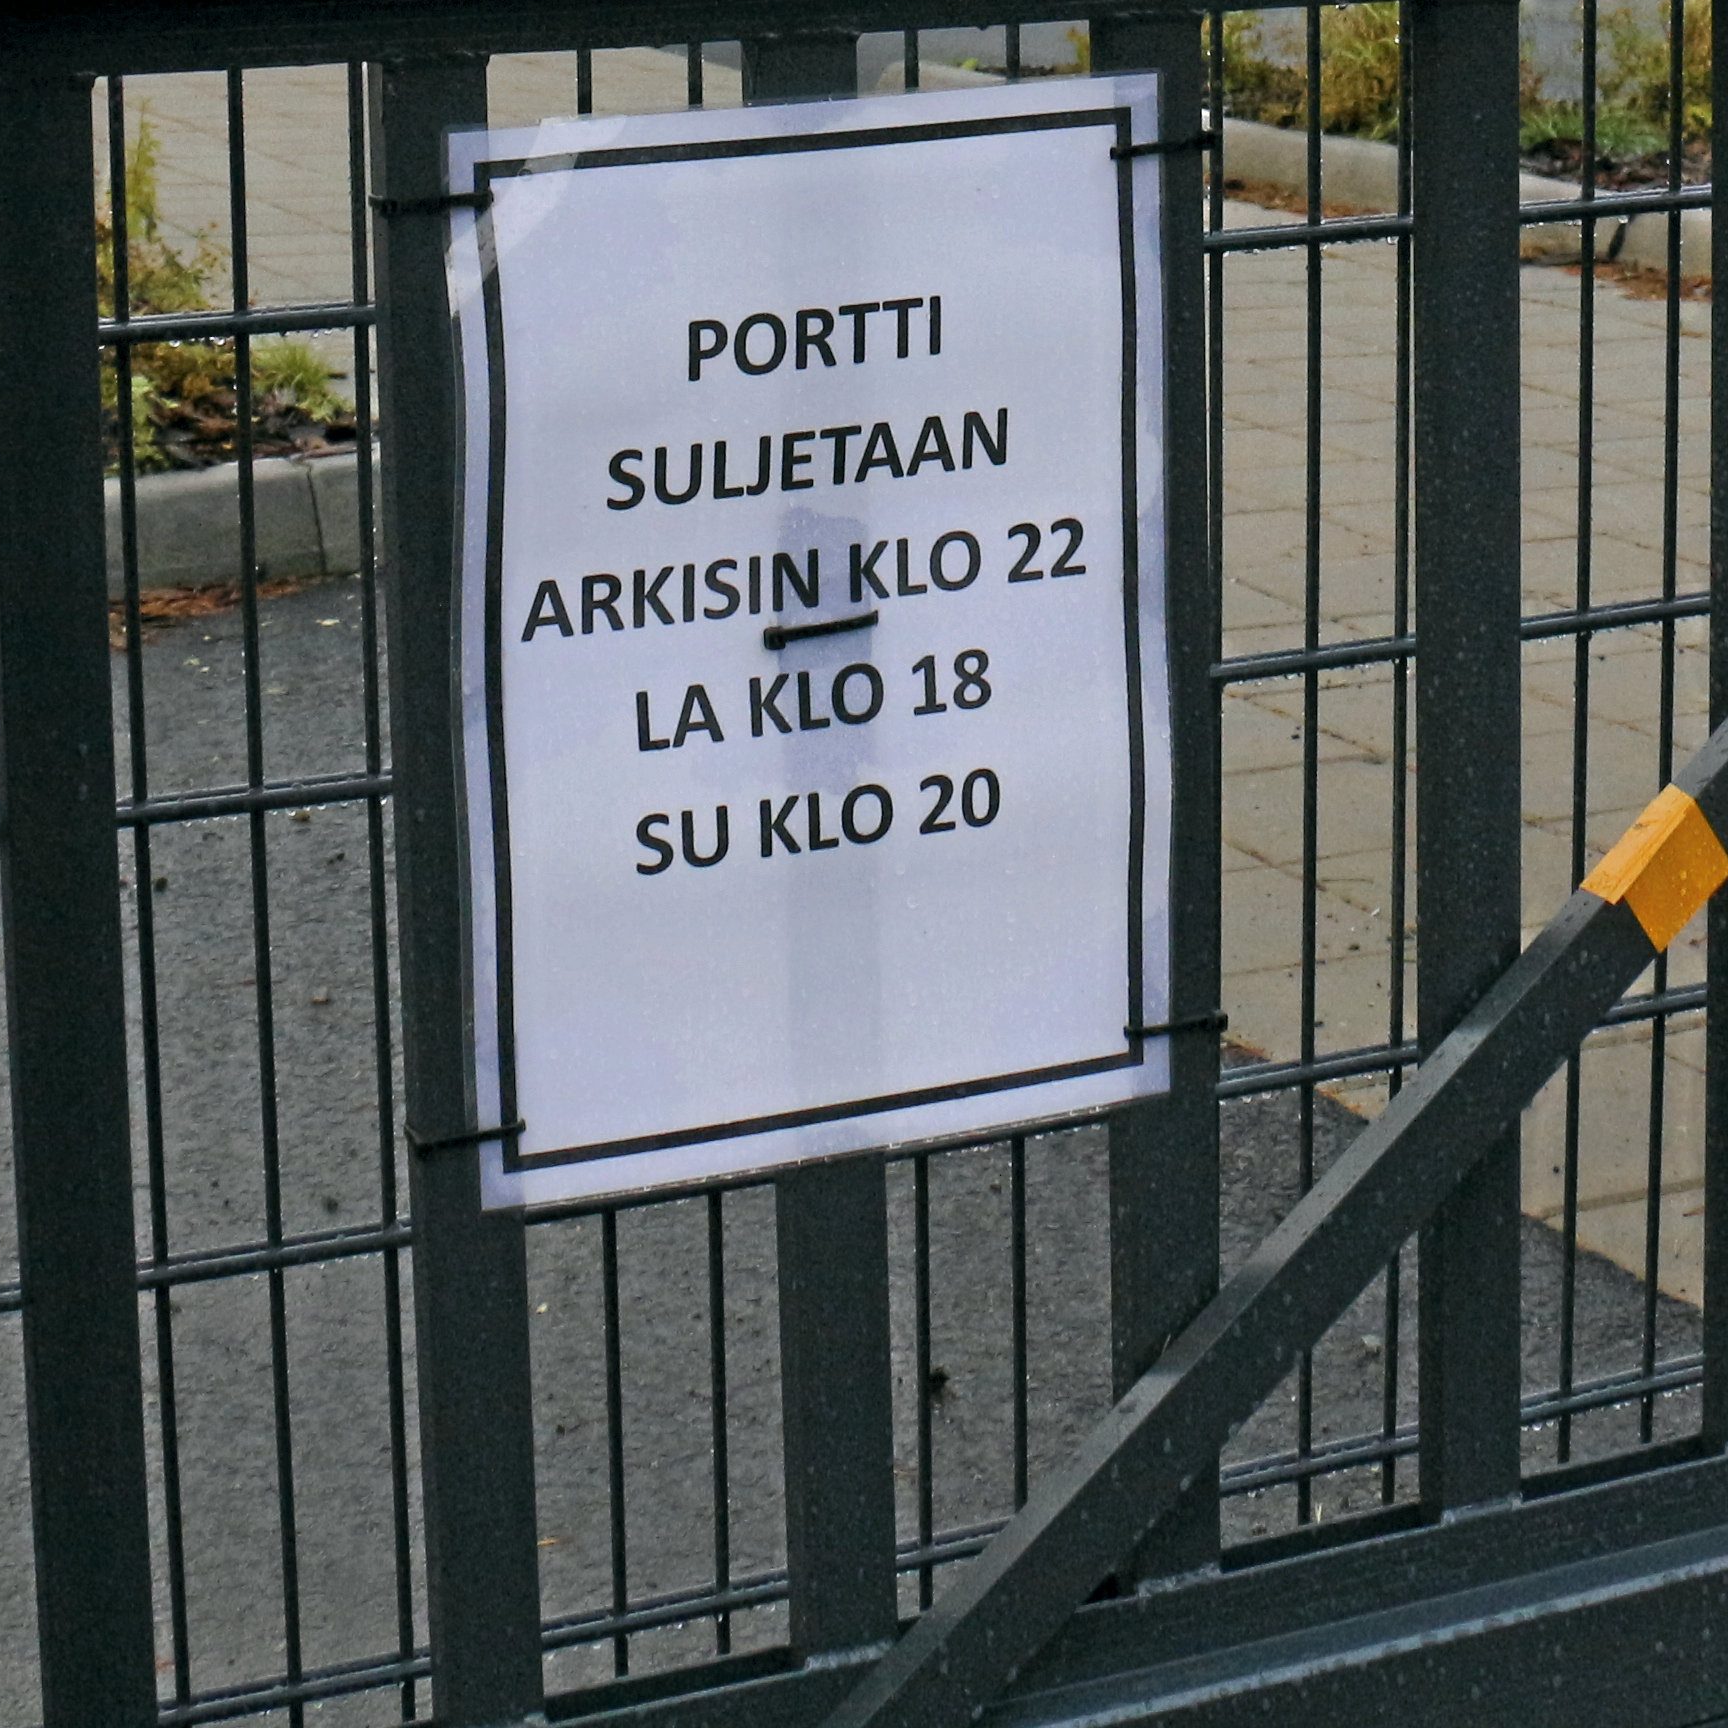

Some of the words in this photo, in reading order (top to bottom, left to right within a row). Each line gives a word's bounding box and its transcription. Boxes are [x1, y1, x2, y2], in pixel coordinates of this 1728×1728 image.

[688, 295, 942, 382] PORTTI
[606, 407, 1008, 511] SULJETAAN
[521, 548, 820, 643] ARKISIN
[849, 530, 982, 604] KLO
[1007, 517, 1087, 584] 22
[635, 684, 725, 752] LA
[749, 663, 884, 738] KLO
[911, 649, 992, 716] 18
[636, 805, 729, 876] SU
[759, 784, 894, 858] KLO
[919, 768, 1001, 835] 20
